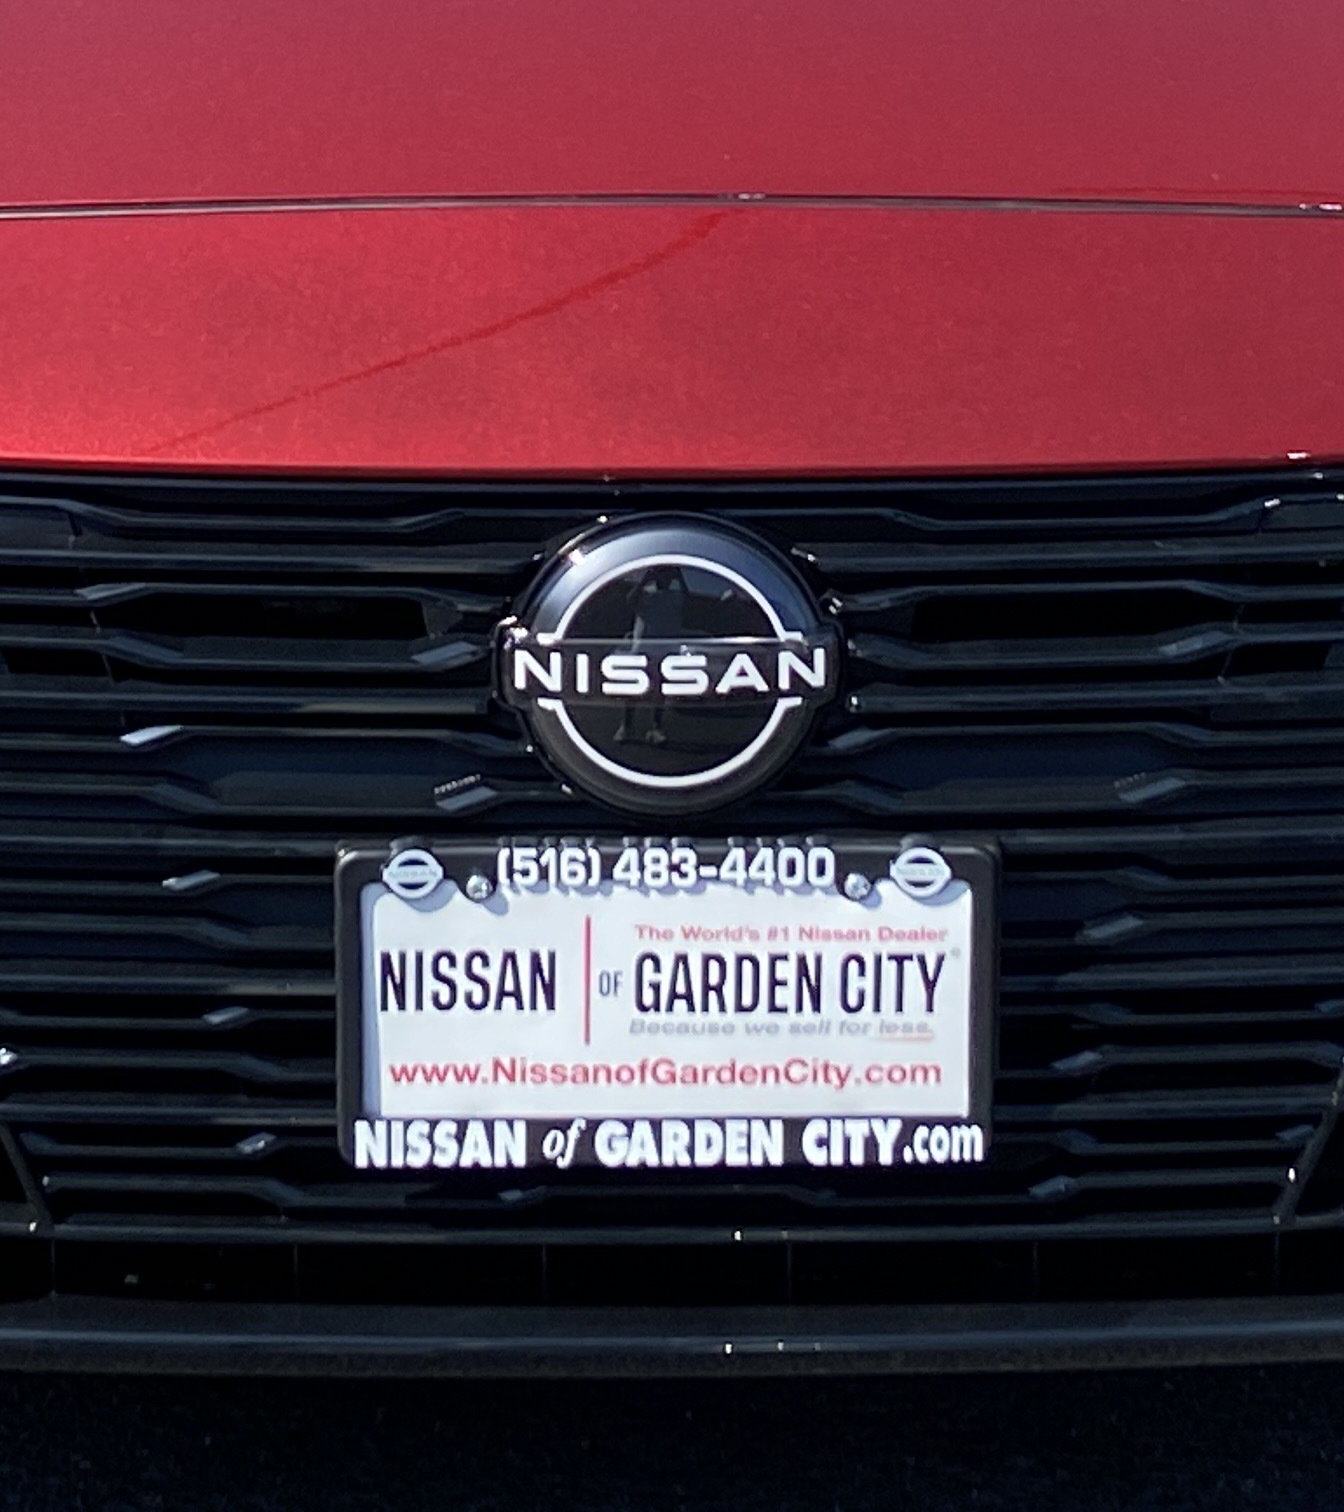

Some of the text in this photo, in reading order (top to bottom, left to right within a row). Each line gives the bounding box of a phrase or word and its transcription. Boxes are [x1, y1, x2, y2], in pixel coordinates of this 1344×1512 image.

[513, 647, 825, 696] NISSAN
[497, 847, 835, 888] (516) 483-4400
[634, 925, 948, 942] The World's #1 Nissan Dealer
[380, 950, 946, 1014] NISSAN OF GARDEN CITY
[629, 1019, 736, 1036] Because
[745, 1023, 780, 1036] we
[789, 1019, 831, 1036] sell
[839, 1019, 871, 1036] for
[390, 1056, 943, 1090] www.NissanofGardenCity.com
[354, 1118, 527, 1168] NISSAN
[542, 1117, 586, 1169] of
[594, 1118, 785, 1167] GARDEN
